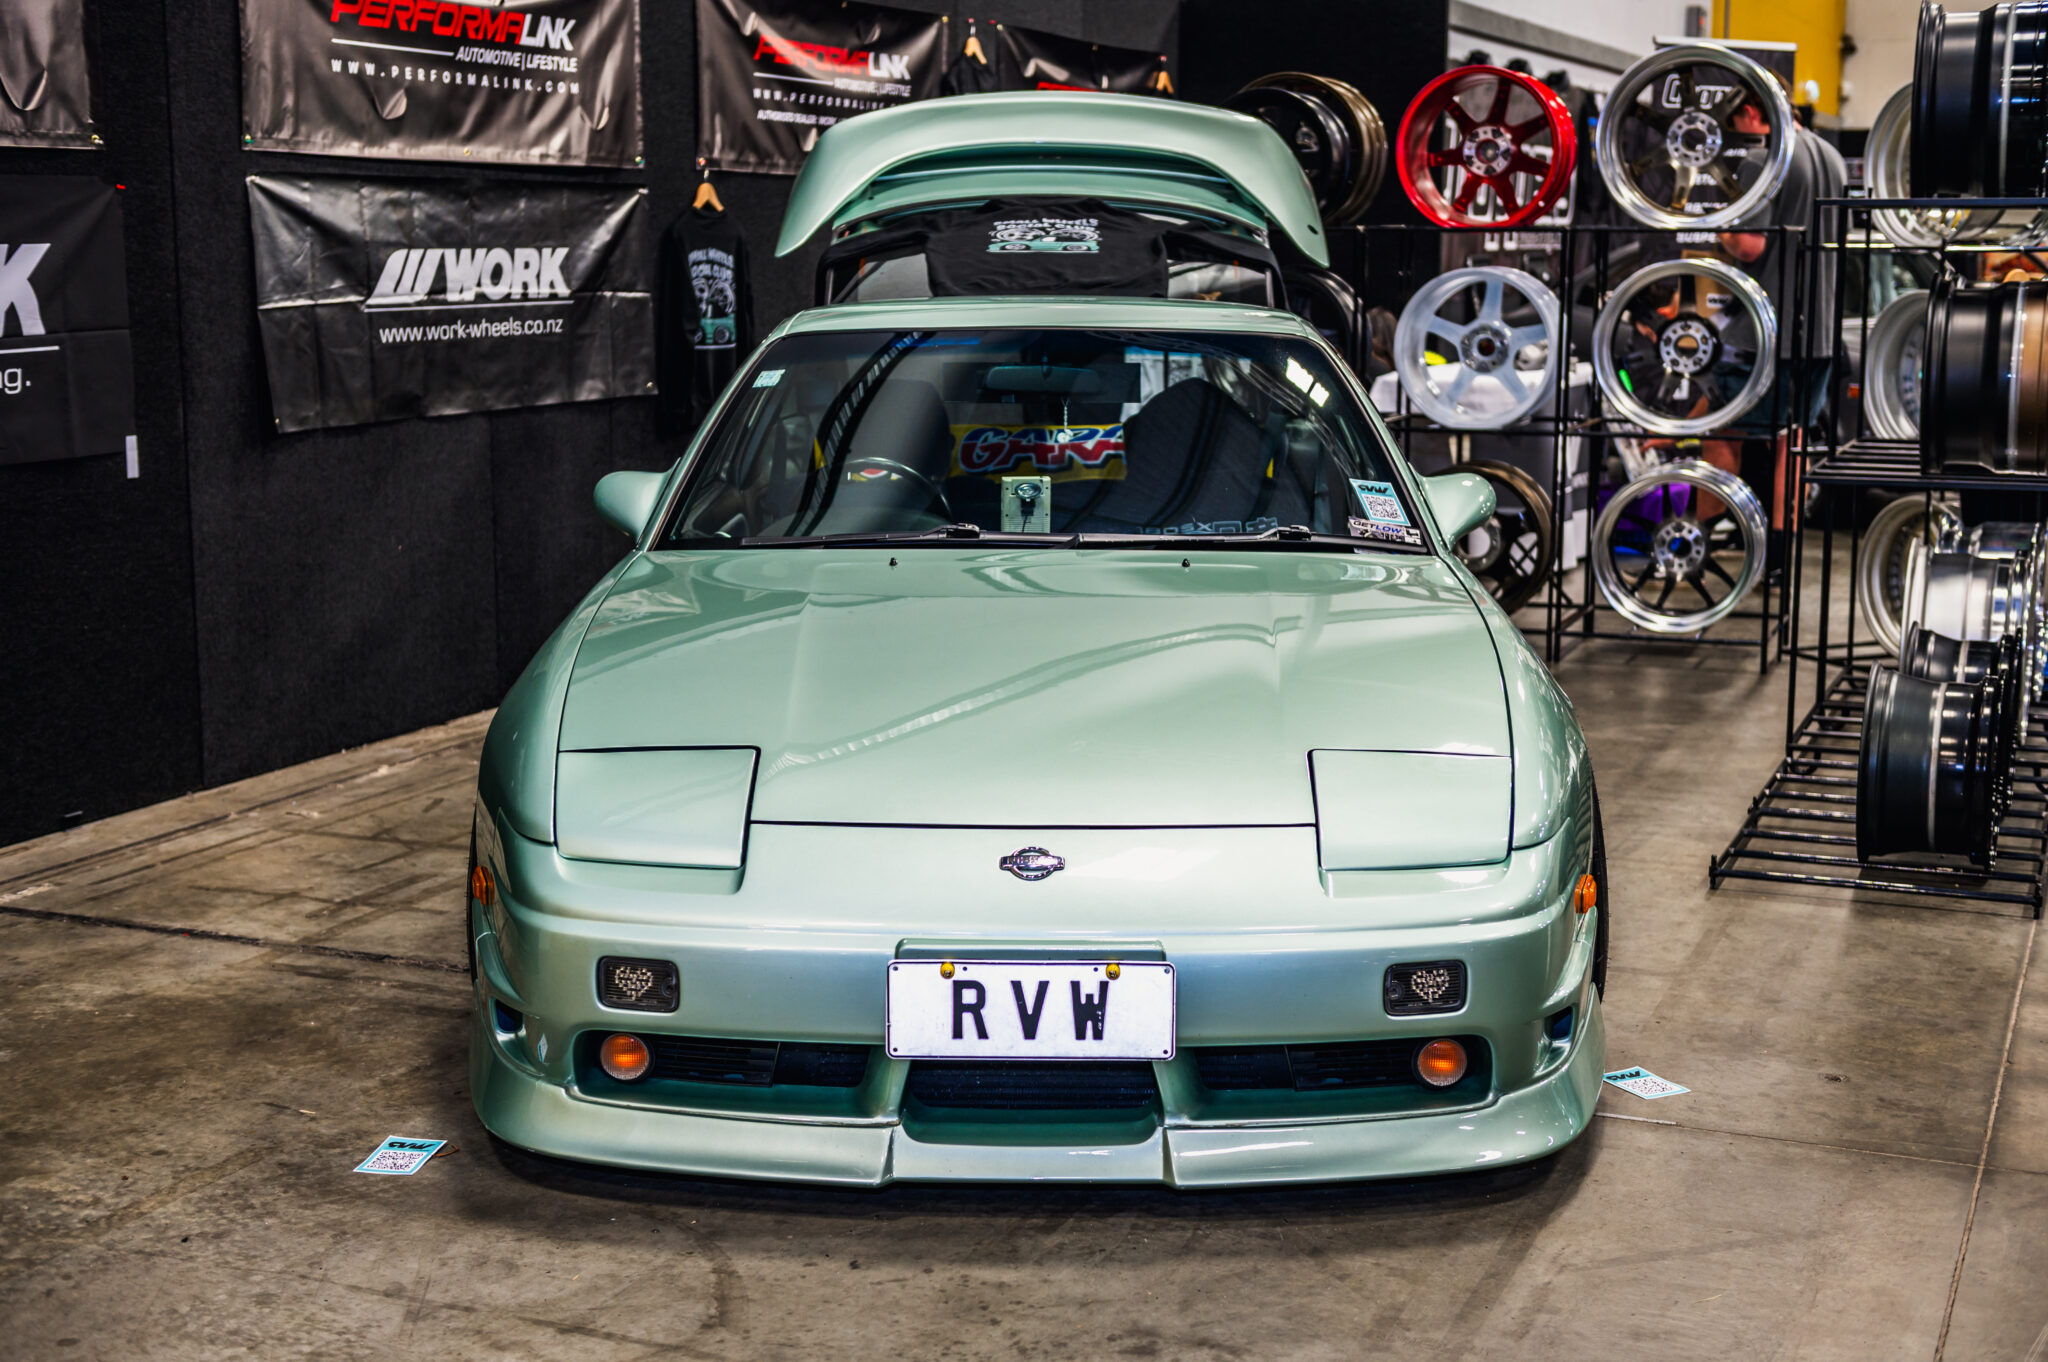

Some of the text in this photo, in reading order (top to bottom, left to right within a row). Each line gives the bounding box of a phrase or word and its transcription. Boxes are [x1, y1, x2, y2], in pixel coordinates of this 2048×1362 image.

[330, 0, 576, 50] PERFORMALINK
[443, 247, 571, 302] WORK
[379, 317, 563, 344] www.work-wheels.co.nz
[0, 368, 31, 394] g.
[952, 979, 1109, 1041] RVW
